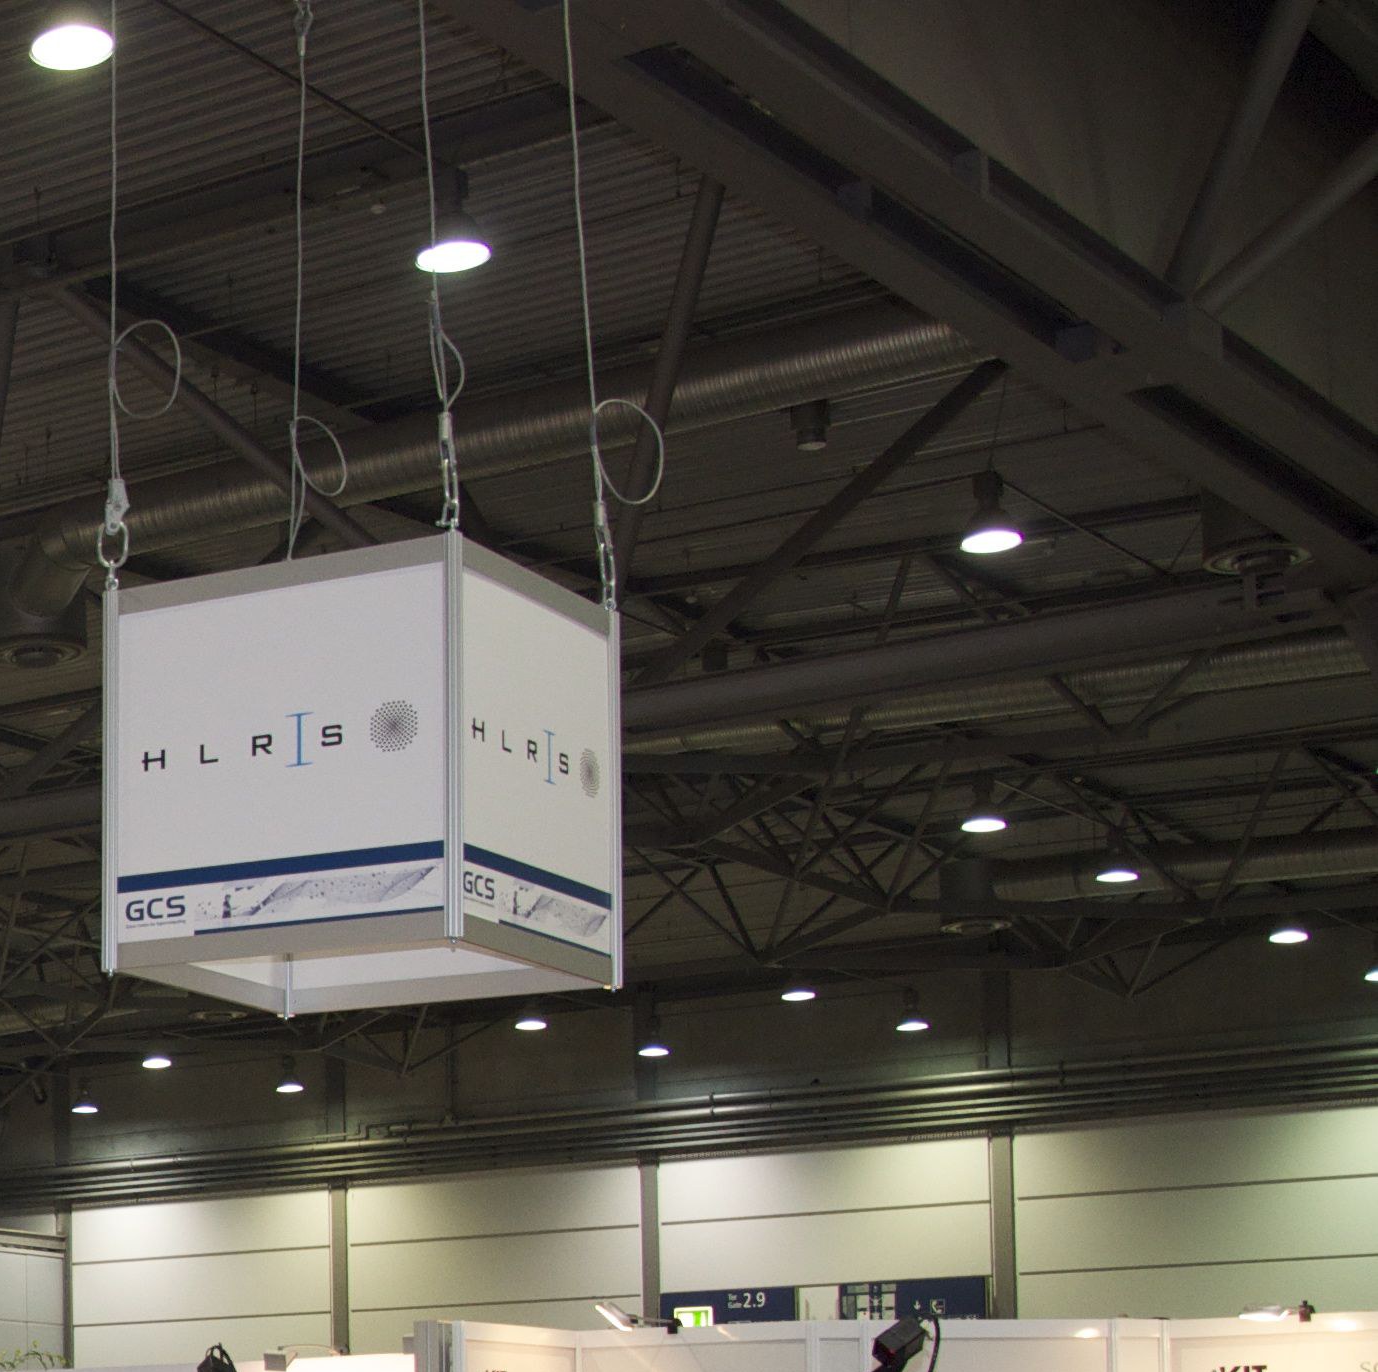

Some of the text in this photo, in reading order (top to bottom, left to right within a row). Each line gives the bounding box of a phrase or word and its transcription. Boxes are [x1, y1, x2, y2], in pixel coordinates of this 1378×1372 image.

[463, 871, 495, 900] GCS
[125, 895, 186, 922] GCS
[742, 1291, 766, 1309] 2.9
